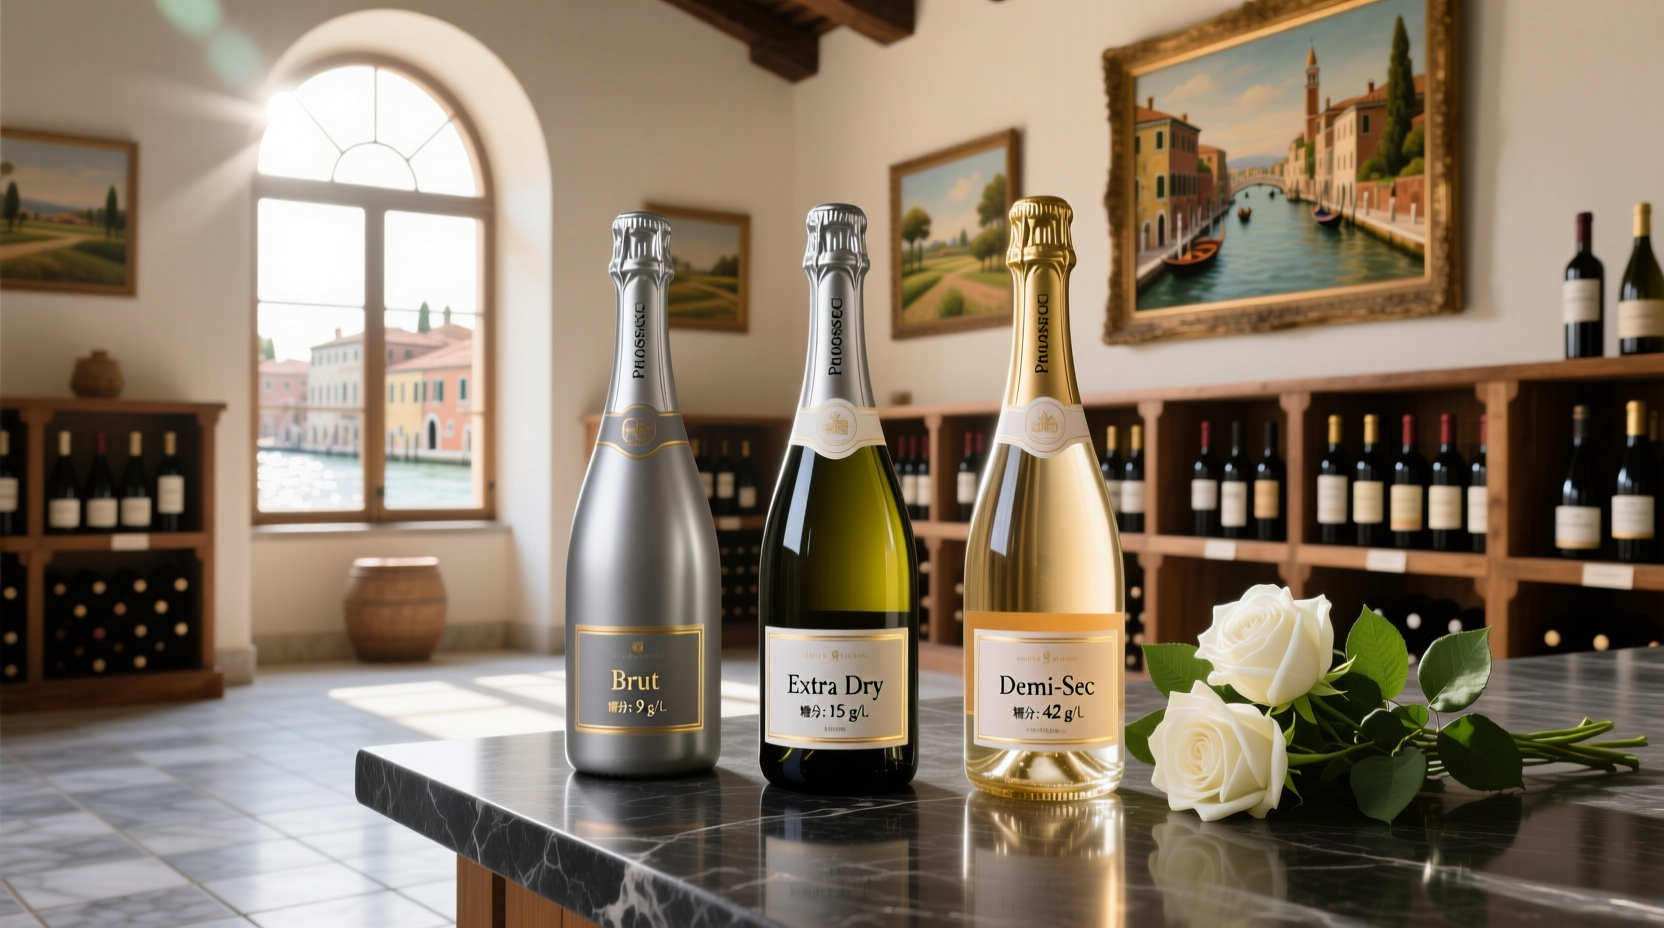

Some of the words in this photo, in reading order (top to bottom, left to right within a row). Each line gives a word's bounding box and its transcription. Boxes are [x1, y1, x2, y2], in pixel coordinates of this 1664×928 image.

[611, 669, 660, 691] Brut
[787, 674, 837, 695] Extra
[845, 675, 884, 700] Dry
[1000, 675, 1095, 696] Demi-Sec
[830, 704, 845, 718] 15
[849, 705, 869, 722] g/L
[1042, 704, 1061, 719] 42
